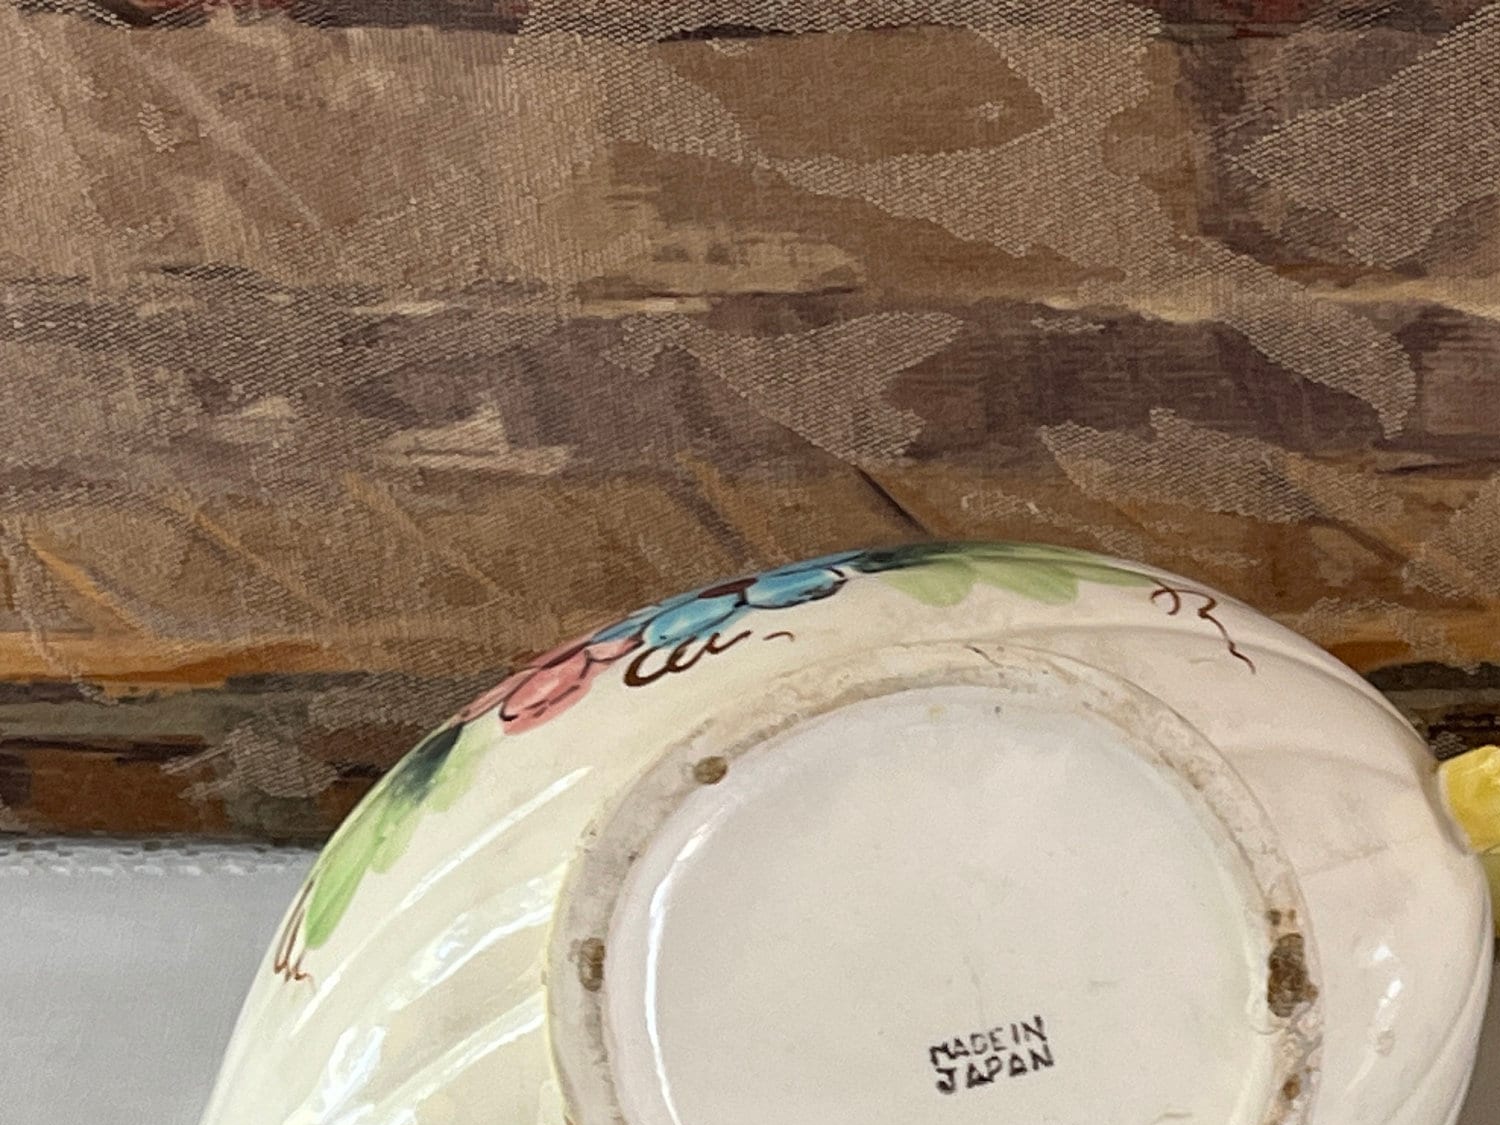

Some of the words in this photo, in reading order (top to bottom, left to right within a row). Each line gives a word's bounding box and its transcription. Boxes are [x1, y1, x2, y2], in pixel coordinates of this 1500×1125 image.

[929, 1027, 1008, 1066] MADE
[1010, 1015, 1047, 1044] IN
[936, 1044, 1054, 1095] JAPAN
